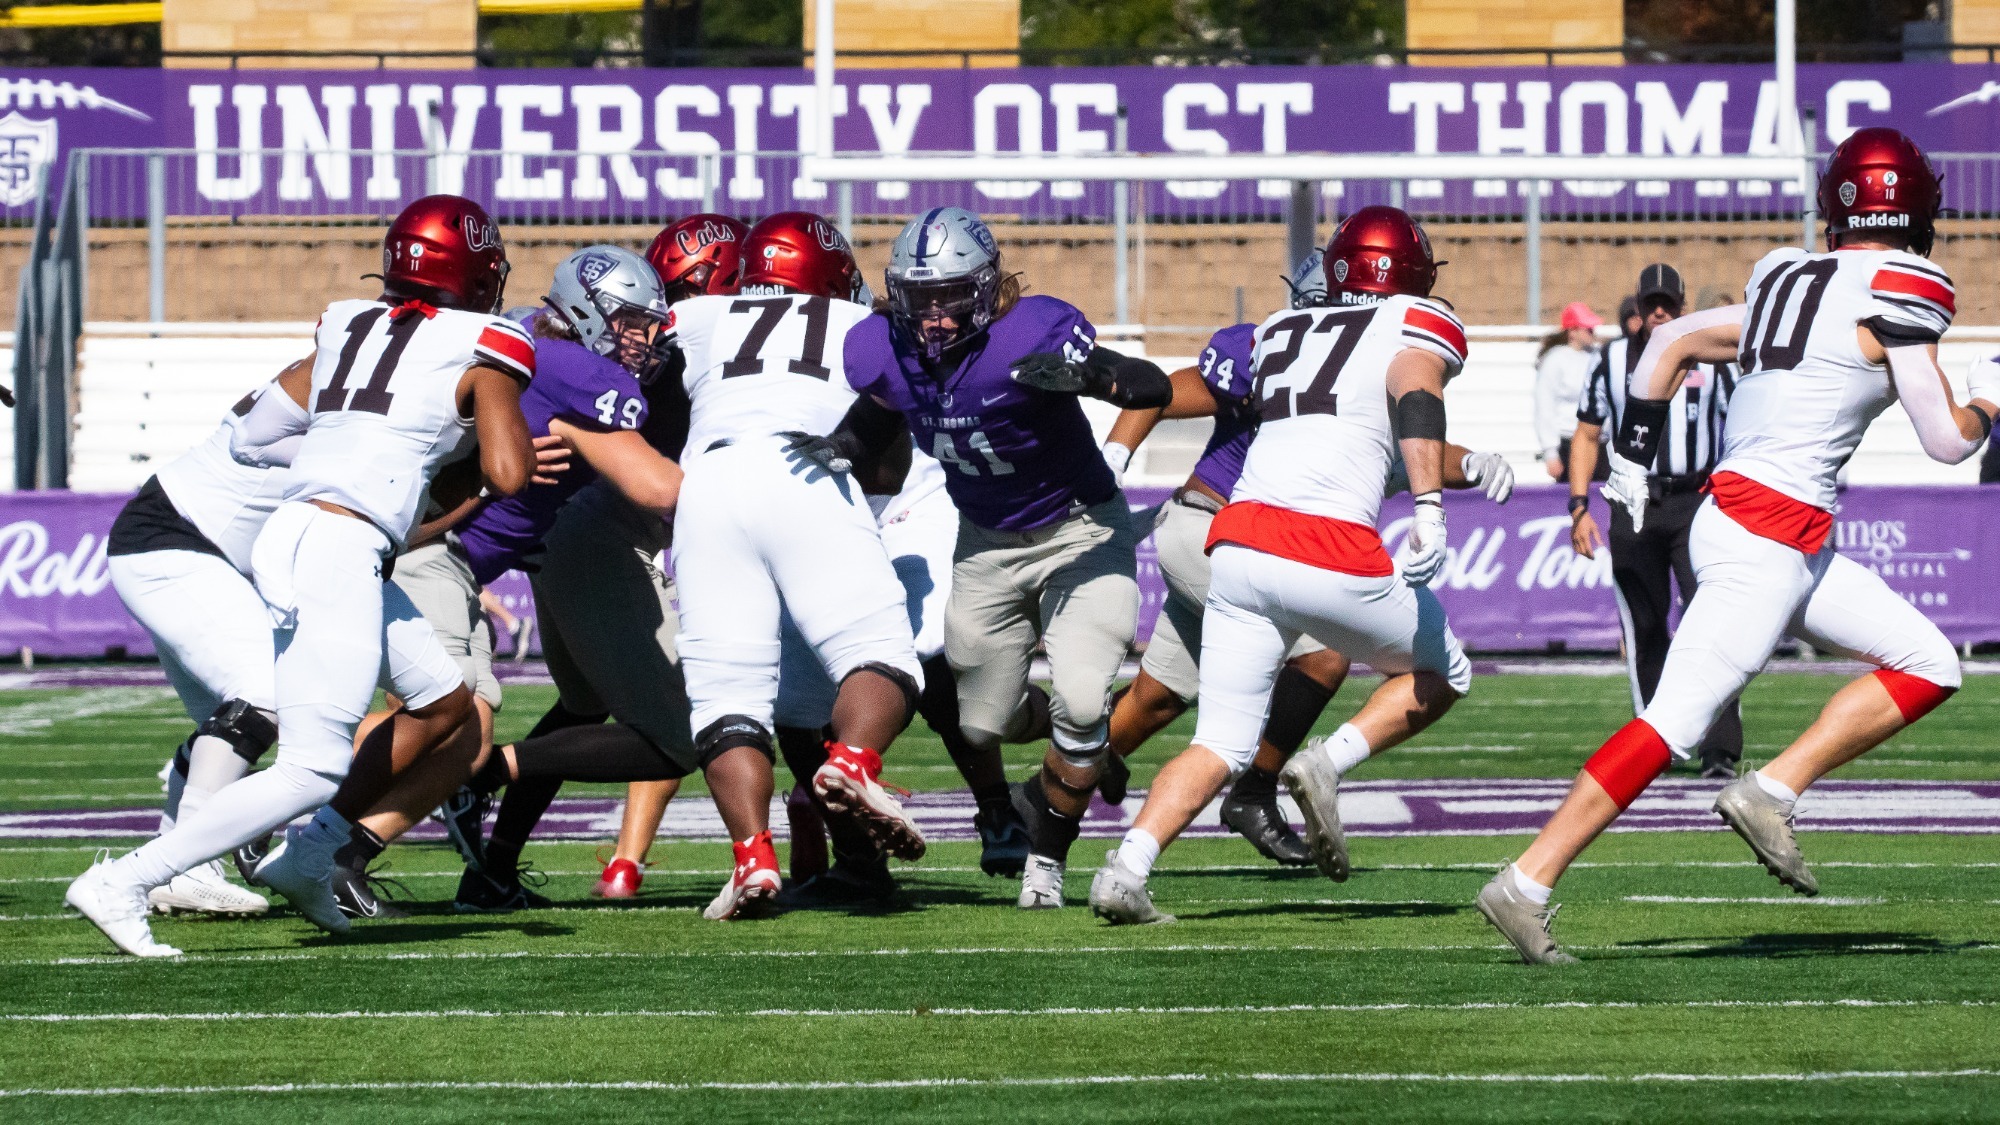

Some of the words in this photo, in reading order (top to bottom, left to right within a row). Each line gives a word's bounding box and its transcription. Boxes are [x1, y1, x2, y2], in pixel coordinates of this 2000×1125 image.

[188, 84, 931, 200] UNIVERSITY
[974, 83, 1117, 198] OF
[1162, 82, 1314, 198] ST
[1885, 188, 1895, 200] 10
[676, 220, 735, 256] Cats
[1848, 213, 1910, 229] Riddell
[410, 259, 420, 271] 11
[764, 260, 773, 271] 71
[1376, 271, 1388, 283] 27
[1341, 291, 1386, 305] Ridd
[1740, 258, 1839, 378] 10
[722, 297, 831, 382] 71
[314, 307, 428, 416] 11
[1200, 346, 1235, 391] 34
[1256, 307, 1379, 422] 27
[594, 389, 643, 430] 49
[938, 416, 981, 429] THOMAS
[932, 431, 1016, 477] 41
[1834, 504, 1907, 563] ings
[0, 520, 110, 598] Roll
[1868, 562, 1947, 578] ANCIAL
